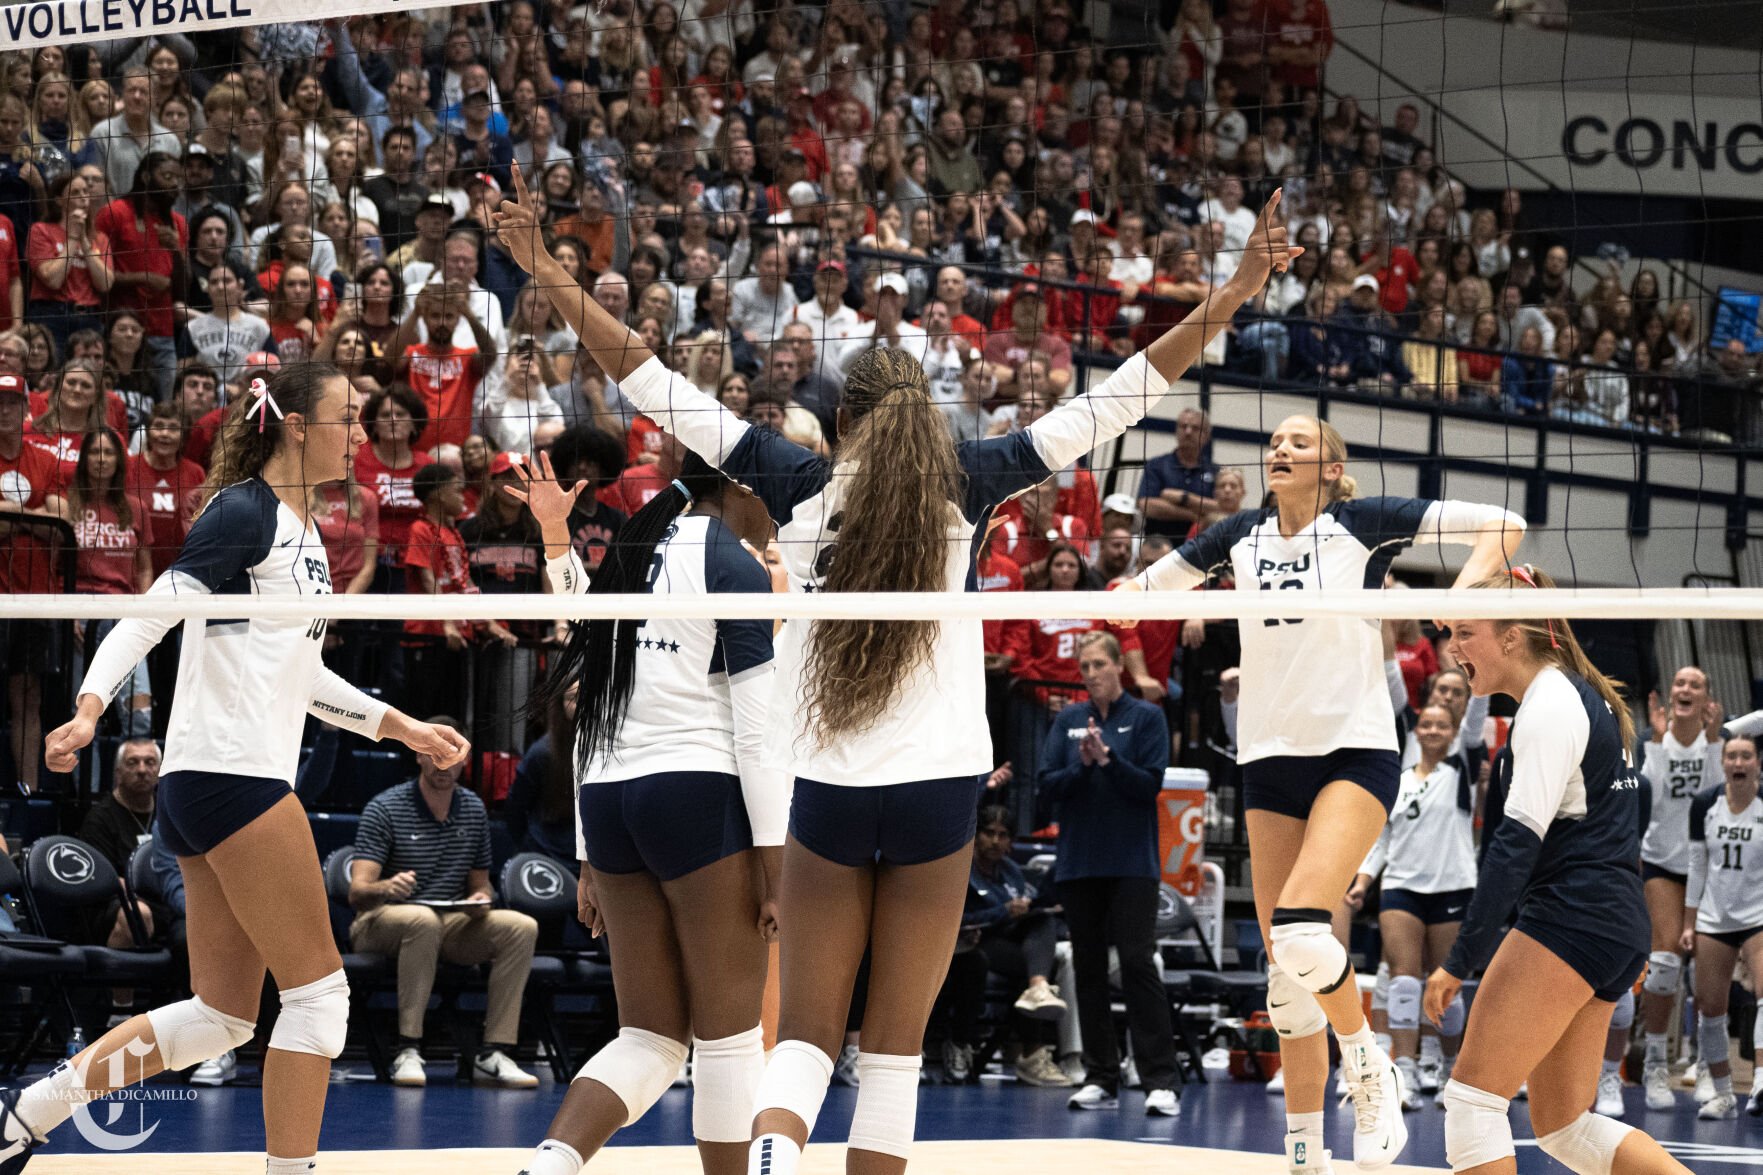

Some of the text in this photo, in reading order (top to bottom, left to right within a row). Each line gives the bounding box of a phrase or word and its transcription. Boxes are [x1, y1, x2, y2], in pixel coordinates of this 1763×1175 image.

[5, 0, 252, 41] VOLLEYBALL
[1562, 115, 1763, 174] CONC
[152, 492, 176, 512] N
[312, 700, 367, 722] NITTANY LIONS
[1669, 759, 1704, 773] PSU
[1717, 825, 1753, 841] PSU
[1721, 843, 1743, 871] 11
